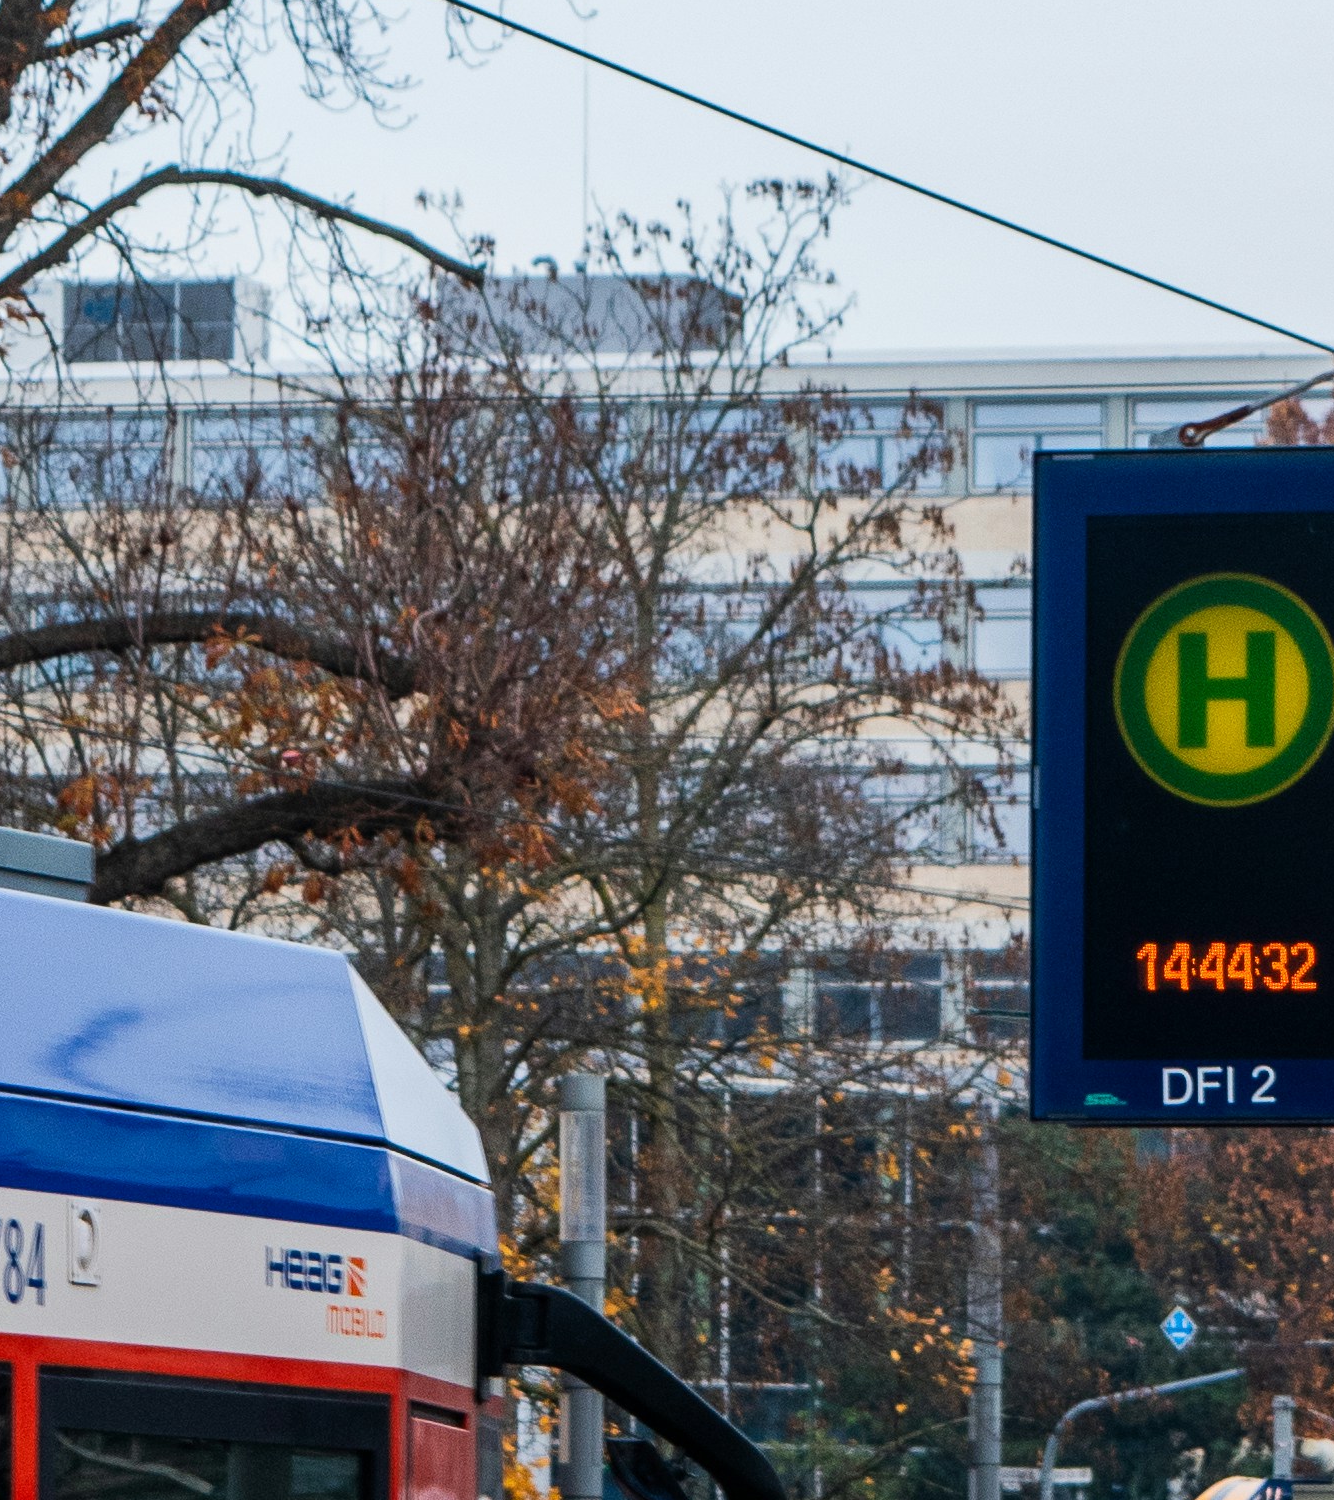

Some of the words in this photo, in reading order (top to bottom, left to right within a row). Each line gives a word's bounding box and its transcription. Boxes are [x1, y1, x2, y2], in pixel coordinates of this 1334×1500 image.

[1178, 631, 1275, 748] H
[1136, 941, 1317, 991] 14:44:32
[1162, 1066, 1235, 1105] DFI
[1251, 1064, 1277, 1103] 2
